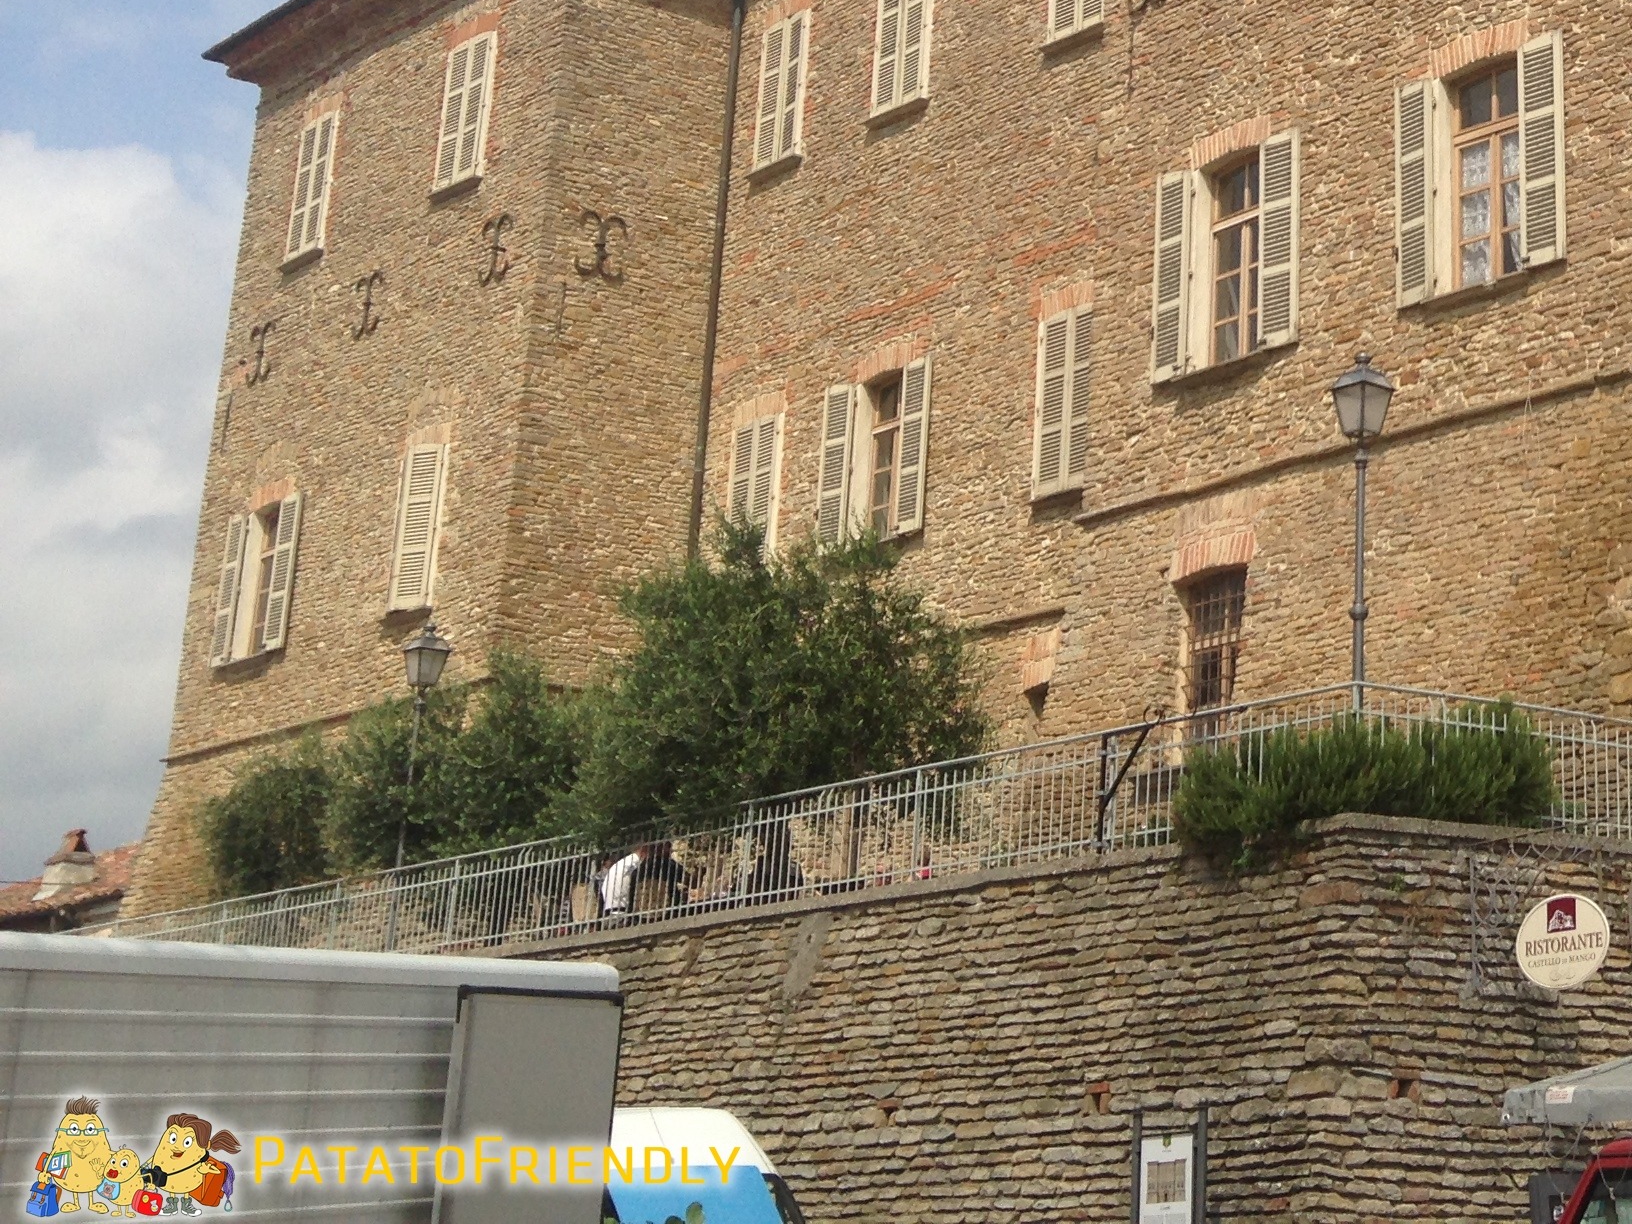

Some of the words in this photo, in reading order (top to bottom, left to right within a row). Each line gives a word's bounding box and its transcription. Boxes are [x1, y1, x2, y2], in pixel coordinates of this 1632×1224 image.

[1525, 932, 1603, 956] RISTORANTE
[1528, 957, 1560, 968] CASTELLO
[1569, 953, 1596, 963] MANGO
